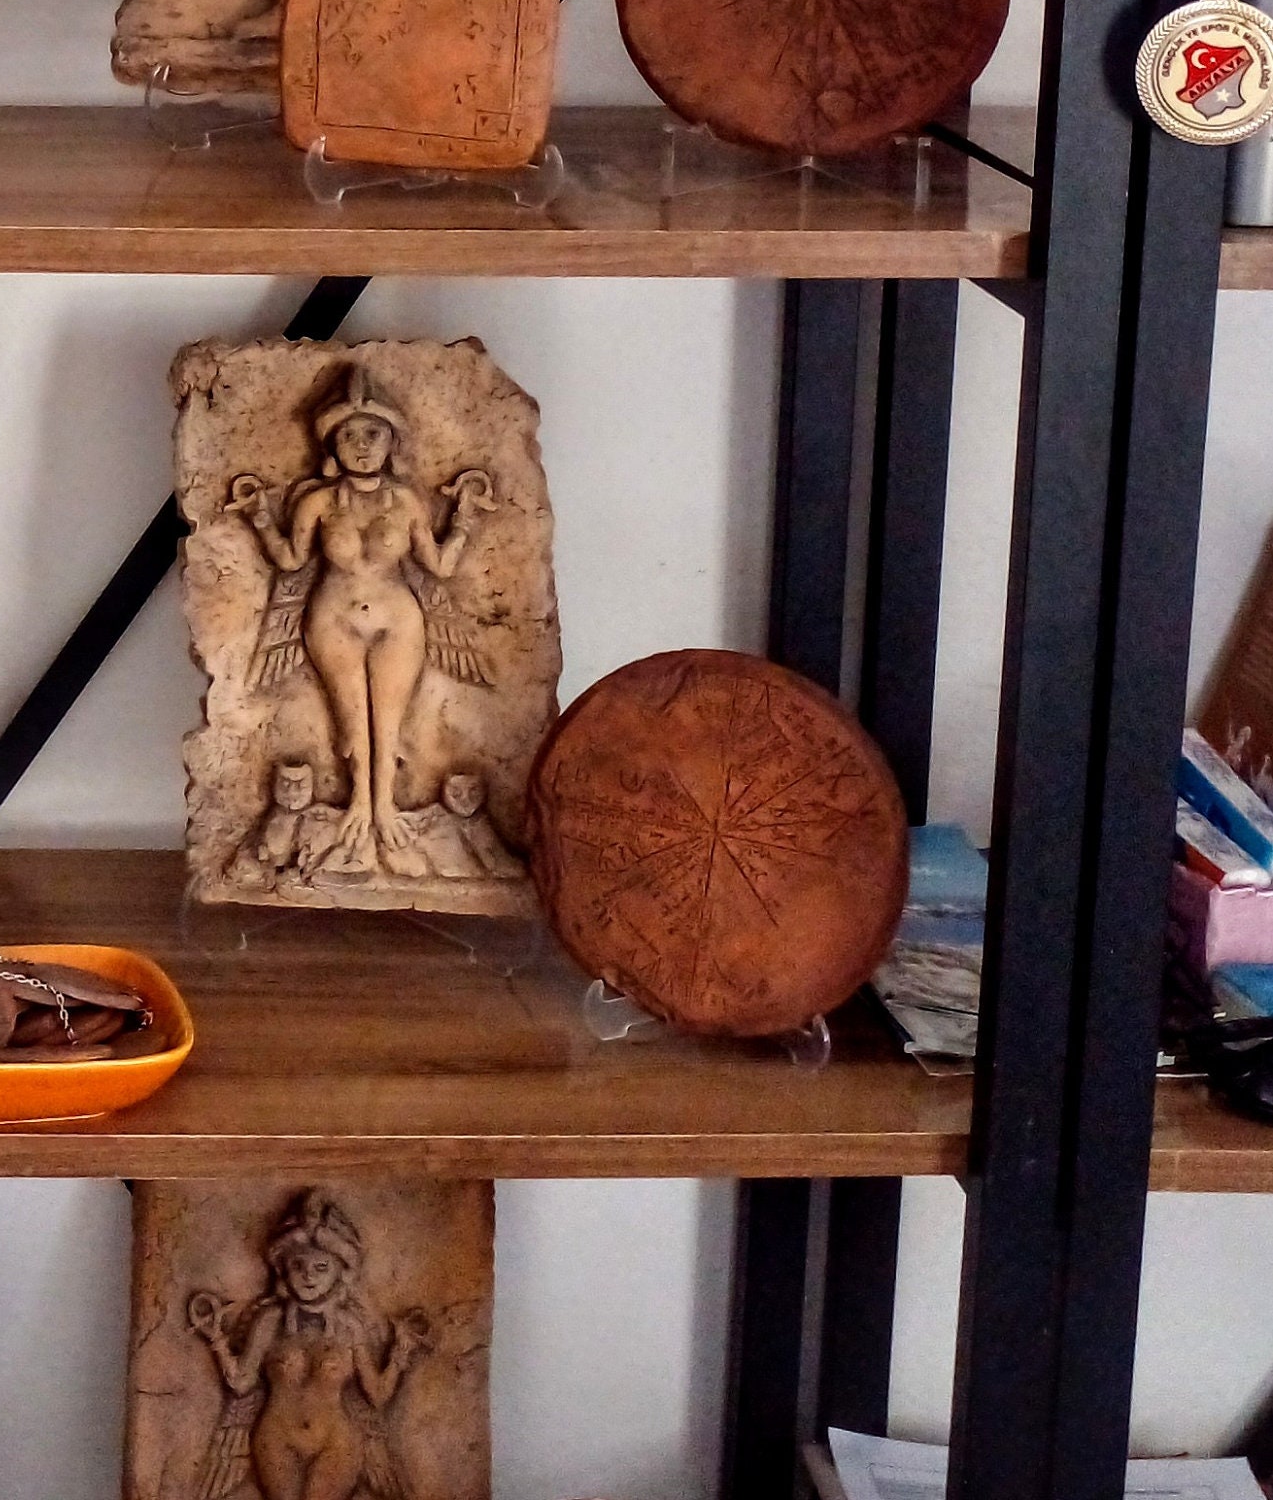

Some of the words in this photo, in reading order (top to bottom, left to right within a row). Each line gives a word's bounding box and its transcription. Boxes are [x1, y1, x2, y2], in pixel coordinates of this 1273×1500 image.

[1185, 28, 1199, 39] VE
[1201, 24, 1230, 34] SPOR
[1188, 55, 1246, 99] ANTALYA
